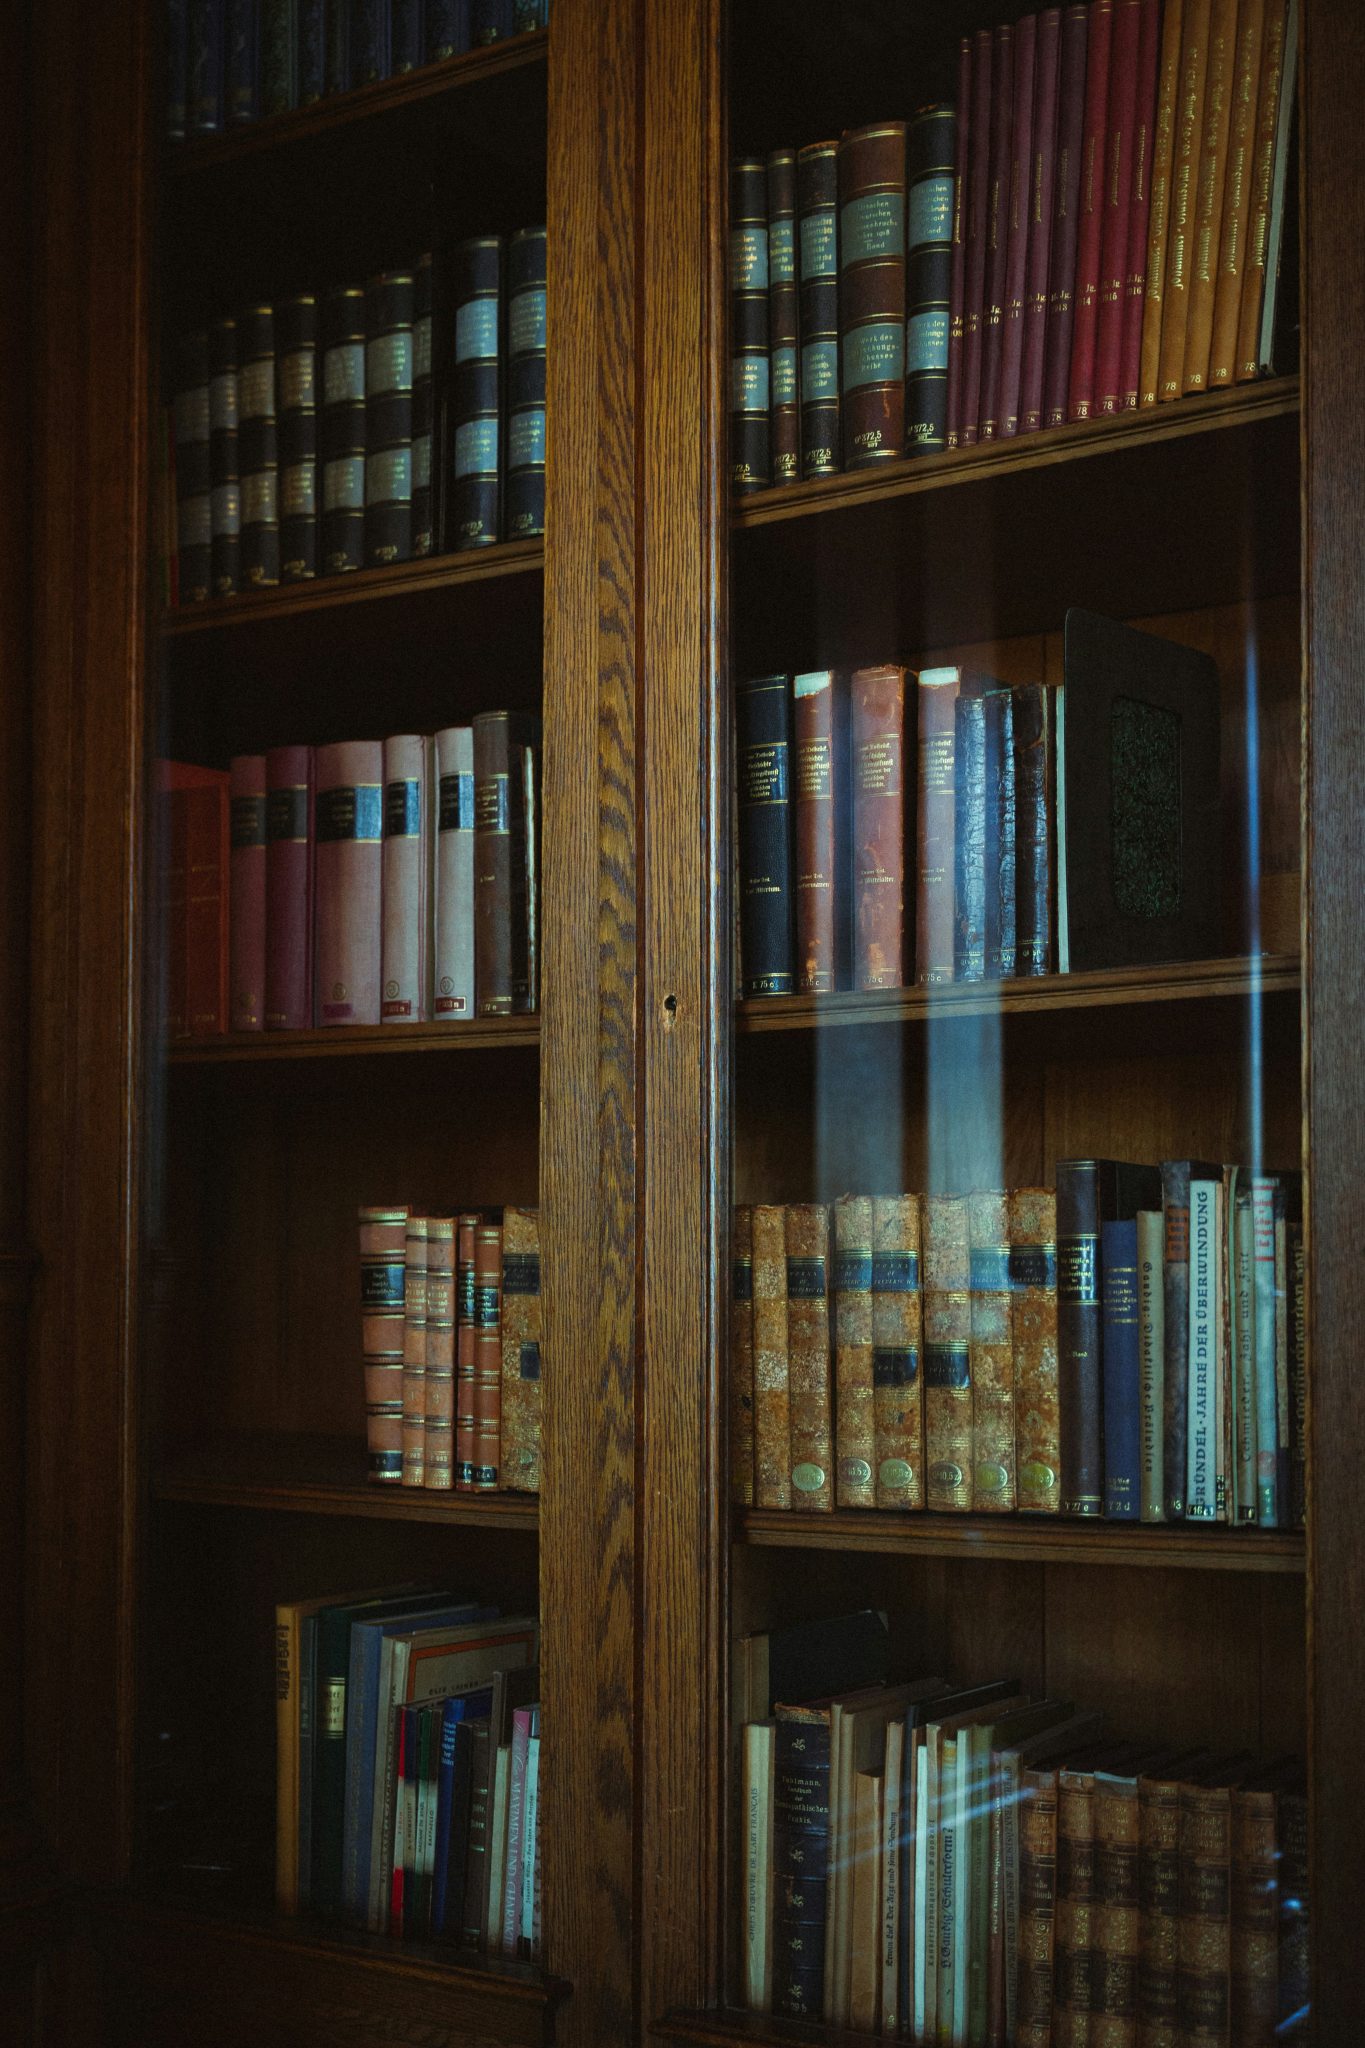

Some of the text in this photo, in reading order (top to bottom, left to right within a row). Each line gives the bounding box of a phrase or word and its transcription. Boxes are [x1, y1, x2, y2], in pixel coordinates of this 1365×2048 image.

[1194, 1191, 1208, 1506] GRÜNDEL JAHRE DER ÜBERWINDUNG
[750, 1788, 758, 1829] FRANÇAIS
[509, 1849, 519, 1877] UND
[750, 1858, 757, 1869] DE
